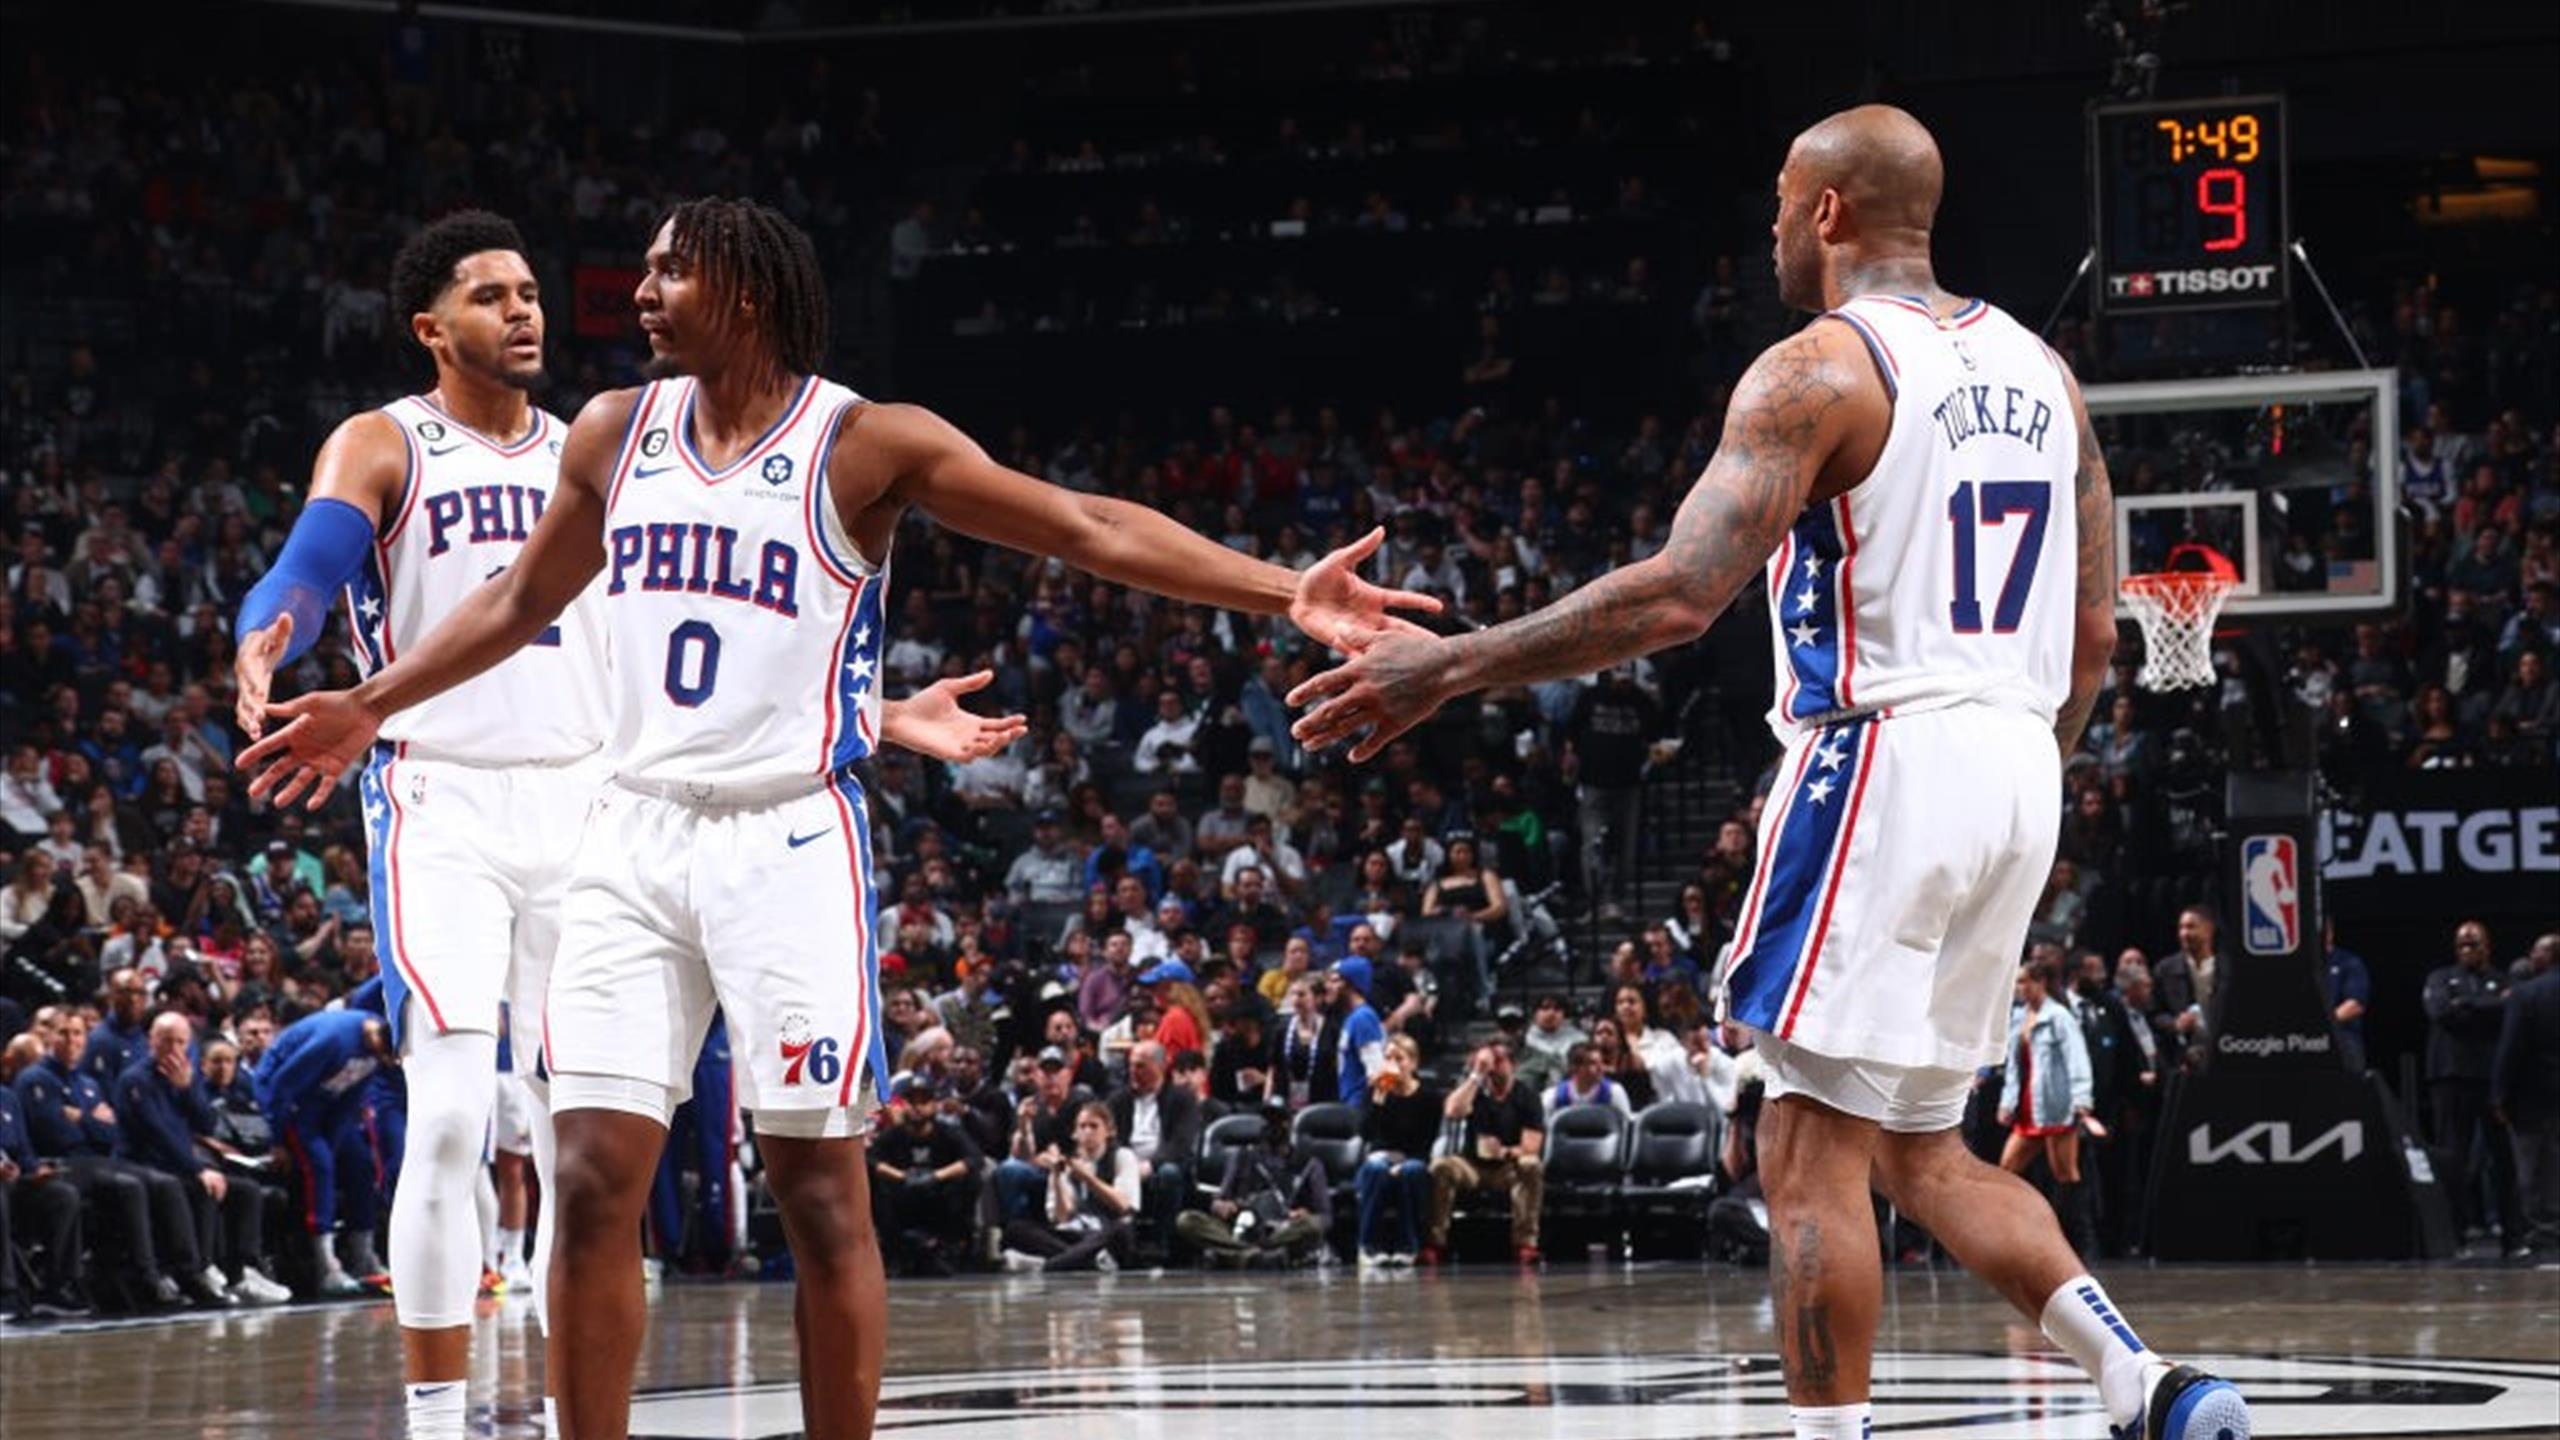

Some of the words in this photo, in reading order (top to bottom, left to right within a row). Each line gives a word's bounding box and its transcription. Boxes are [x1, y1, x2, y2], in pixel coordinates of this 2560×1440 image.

[2157, 114, 2259, 162] 7:49
[2199, 168, 2245, 251] 9
[2155, 265, 2275, 295] TISSOT
[1933, 384, 2052, 452] TUCKER
[607, 522, 799, 619] PHILA
[1948, 480, 2051, 634] 17
[664, 618, 721, 709] 0
[780, 1036, 841, 1086] 76
[2219, 1033, 2285, 1057] Google
[2287, 1032, 2330, 1053] Pixel
